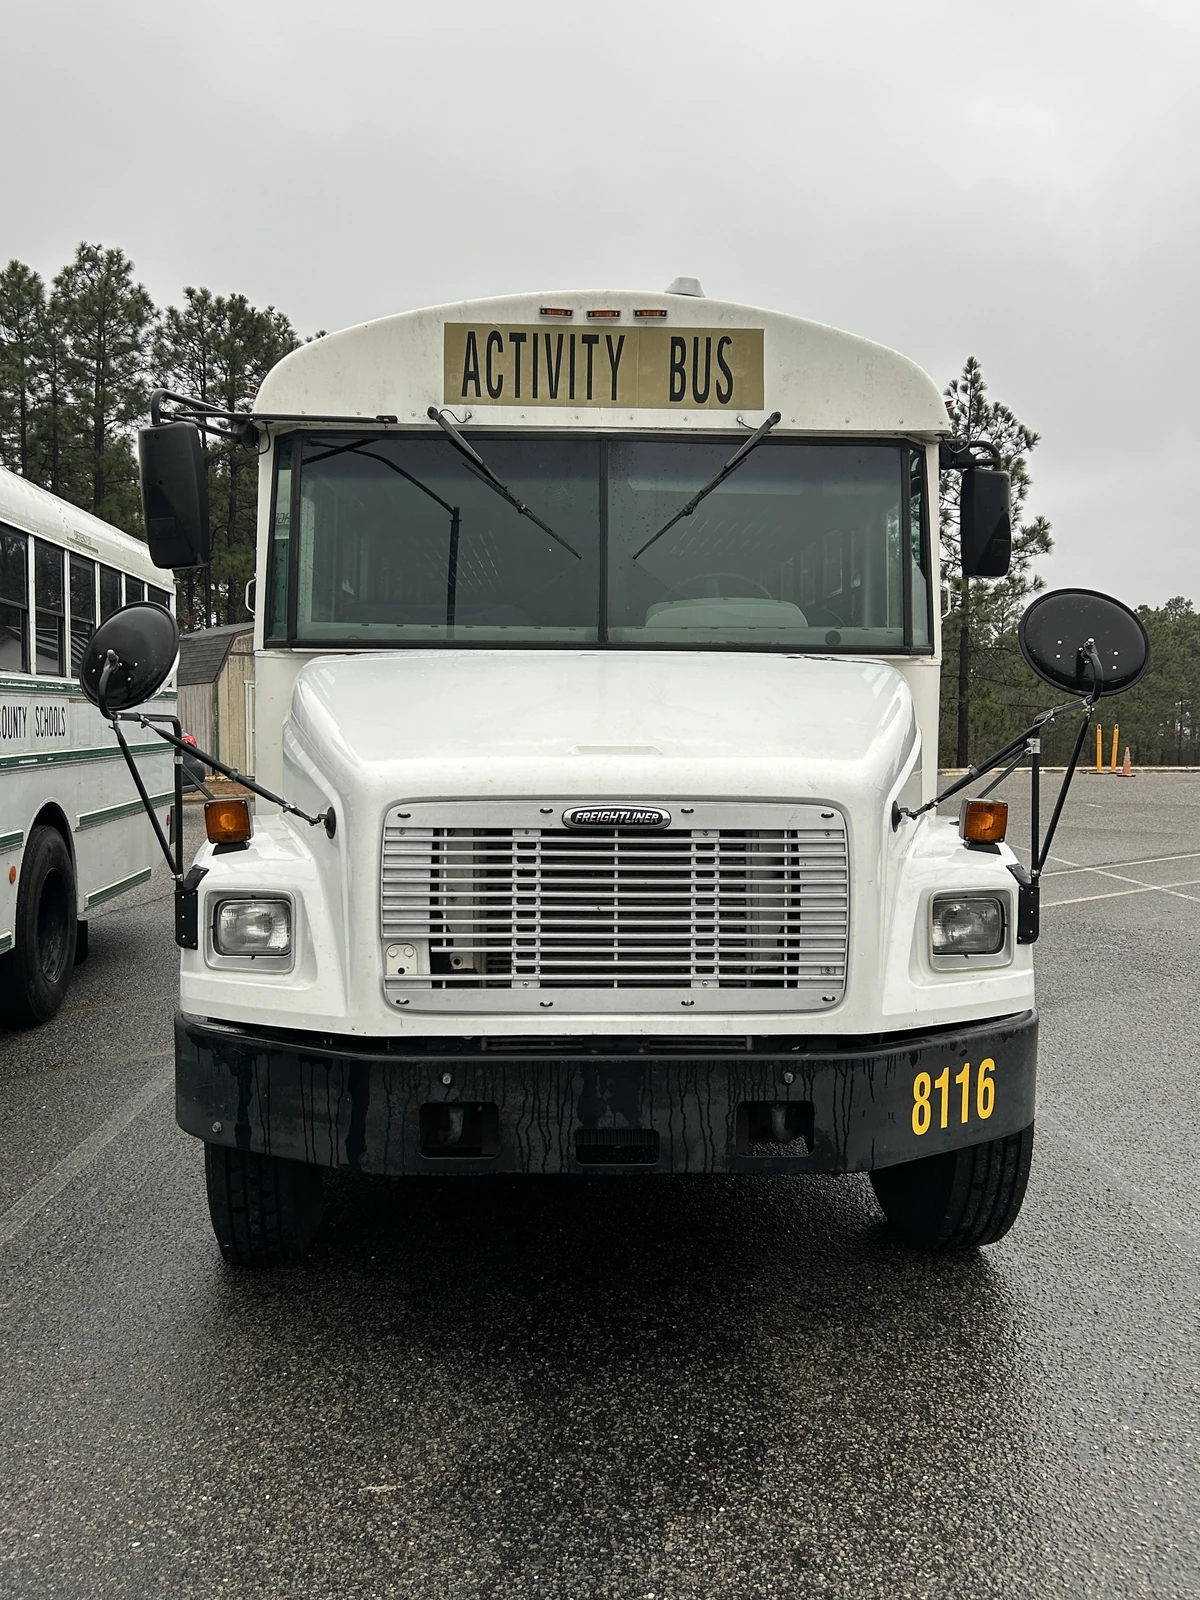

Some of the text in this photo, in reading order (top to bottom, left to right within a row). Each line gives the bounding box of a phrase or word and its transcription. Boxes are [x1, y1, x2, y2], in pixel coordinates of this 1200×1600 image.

[461, 330, 734, 404] ACTIVITY BUS
[0, 705, 66, 739] OUNTY SCHOOLS
[574, 811, 660, 824] FREIGHTLINER
[911, 1057, 996, 1136] 8116
